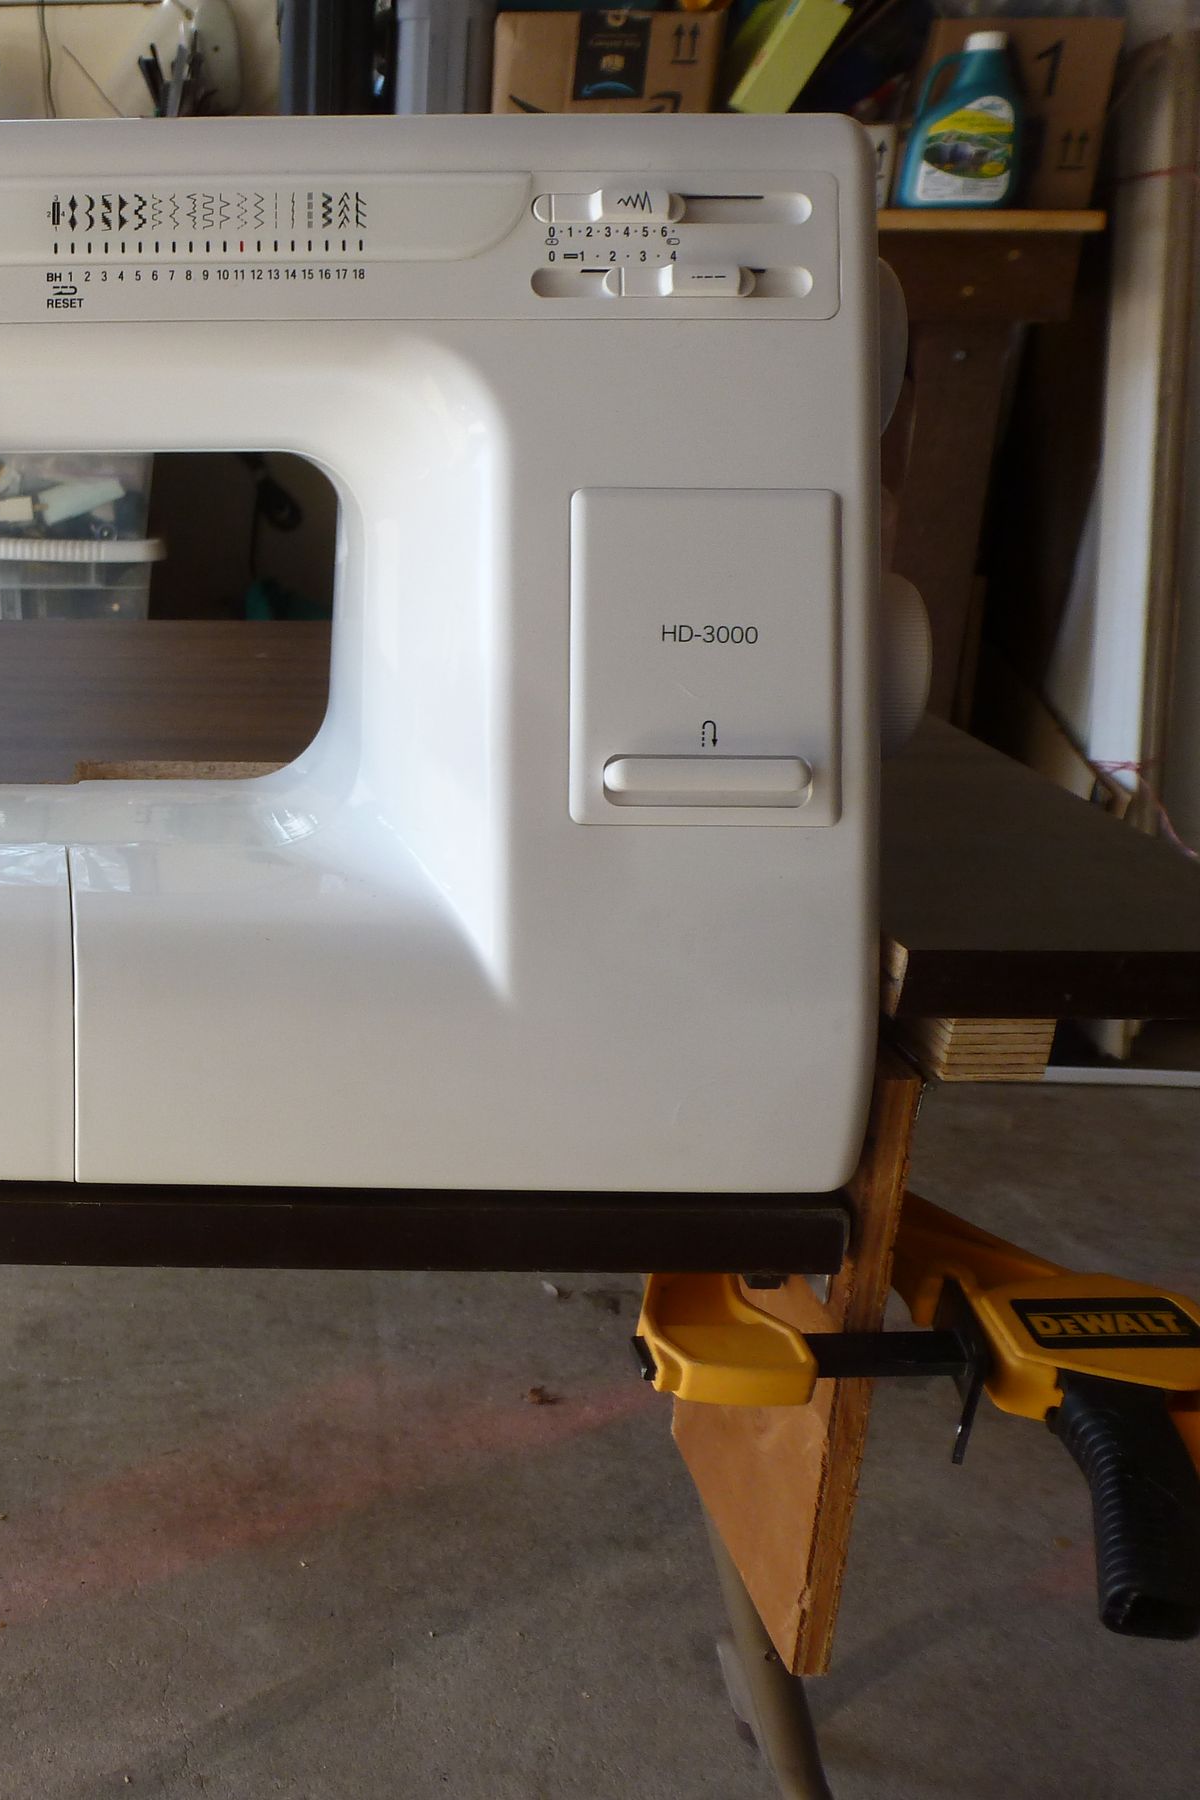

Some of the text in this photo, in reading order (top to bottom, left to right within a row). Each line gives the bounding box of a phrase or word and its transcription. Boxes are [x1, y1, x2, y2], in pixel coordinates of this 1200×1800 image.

[548, 225, 668, 238] 0 1 2 3 4 5 6
[548, 250, 677, 263] 0 1 2 3 4
[46, 268, 366, 283] BH 1 2 3 4 5 6 7 8 9 10 11 12 13 14 15 16 17 18
[46, 298, 84, 309] RESET
[661, 624, 759, 644] HD-3000
